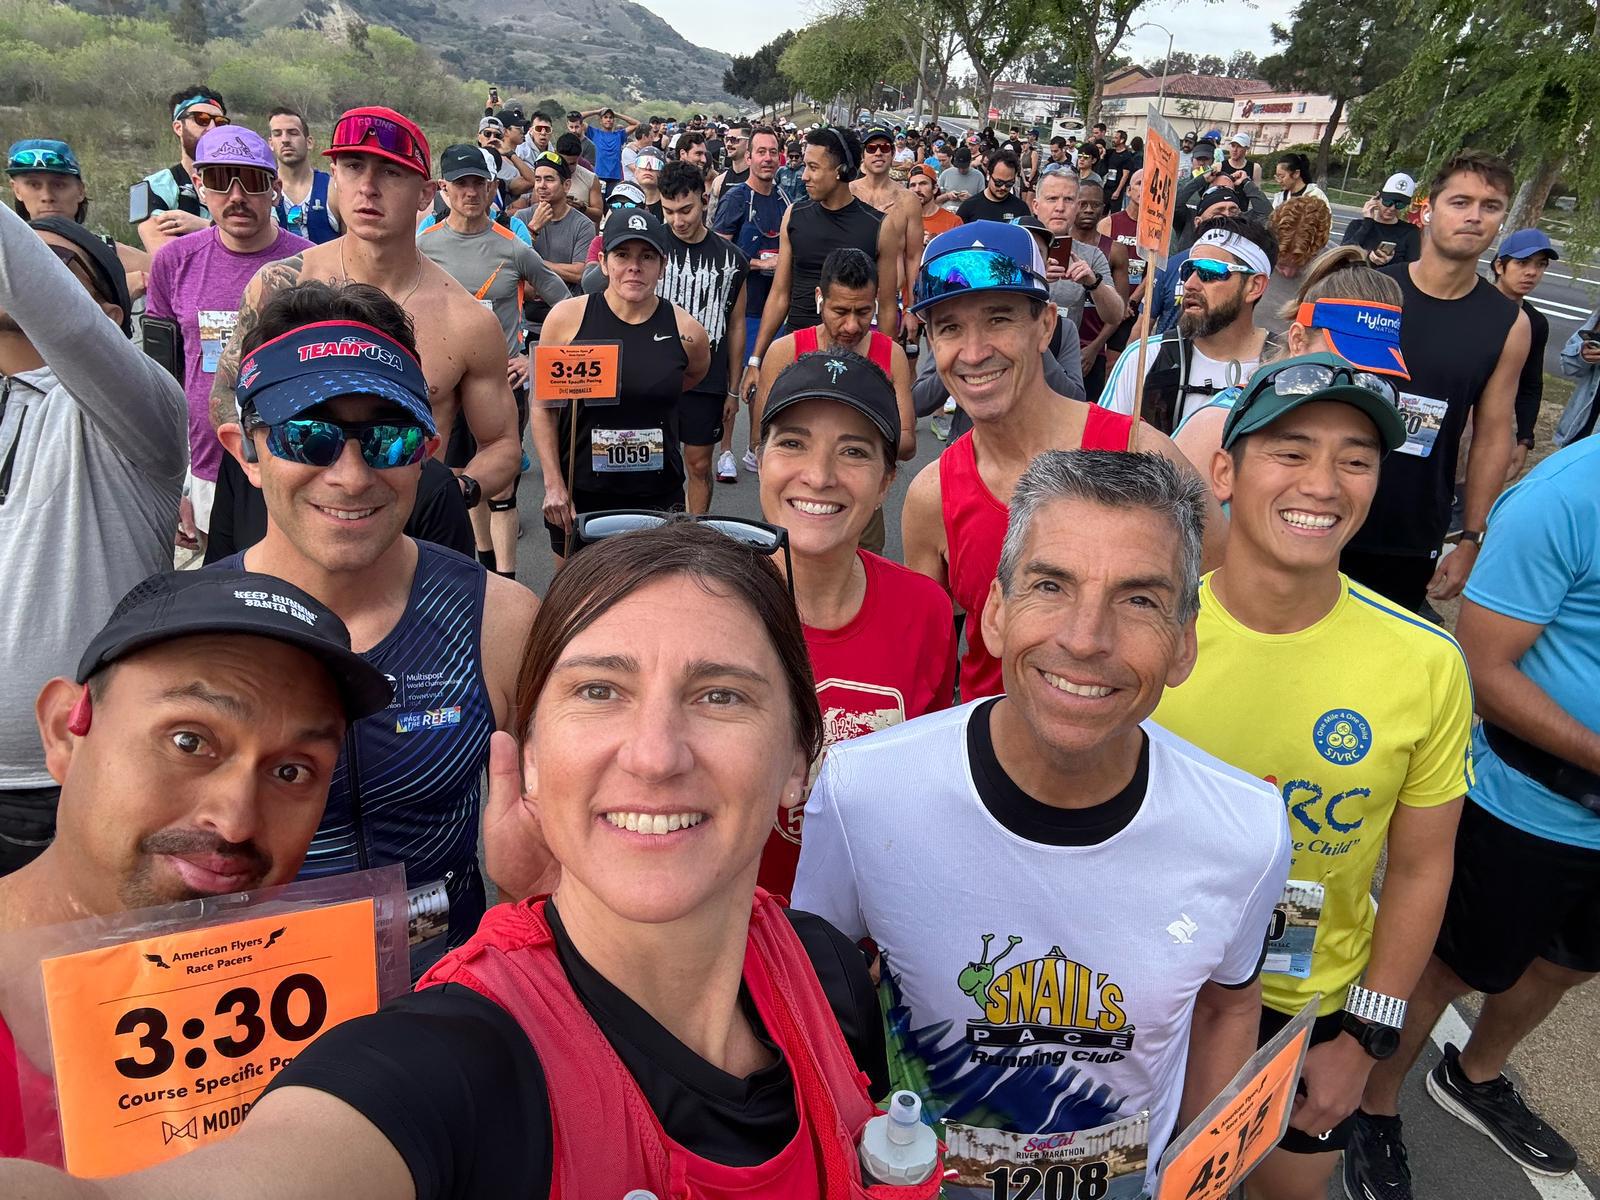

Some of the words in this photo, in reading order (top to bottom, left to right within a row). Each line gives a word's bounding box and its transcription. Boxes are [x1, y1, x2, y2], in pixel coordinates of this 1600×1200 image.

[298, 342, 362, 362] TEAM
[364, 345, 404, 372] USA
[550, 360, 602, 379] 3:45
[606, 445, 650, 464] 1059
[233, 590, 269, 600] KEEP
[244, 599, 288, 613] SANTA
[406, 672, 444, 681] Multisport
[422, 711, 456, 726] REEF
[1316, 722, 1327, 737] One
[1323, 713, 1339, 724] Mile
[1346, 712, 1360, 725] One
[1358, 722, 1369, 741] Child
[1324, 747, 1361, 762] SJVRC
[172, 945, 228, 962] American
[231, 937, 263, 952] Flyers
[1044, 945, 1067, 958] A
[186, 963, 214, 975] Race
[217, 954, 253, 969] Pacers
[114, 972, 328, 1080] 3:30
[973, 1029, 1129, 1048] PACE
[970, 1050, 1068, 1068] Running
[1071, 1050, 1126, 1064] Club
[118, 1086, 188, 1110] Course
[195, 1062, 264, 1094] Specific
[1024, 1131, 1076, 1153] SoCal
[1016, 1151, 1040, 1160] RIVER
[1042, 1147, 1085, 1160] MARATHON
[984, 1161, 1109, 1200] 1208
